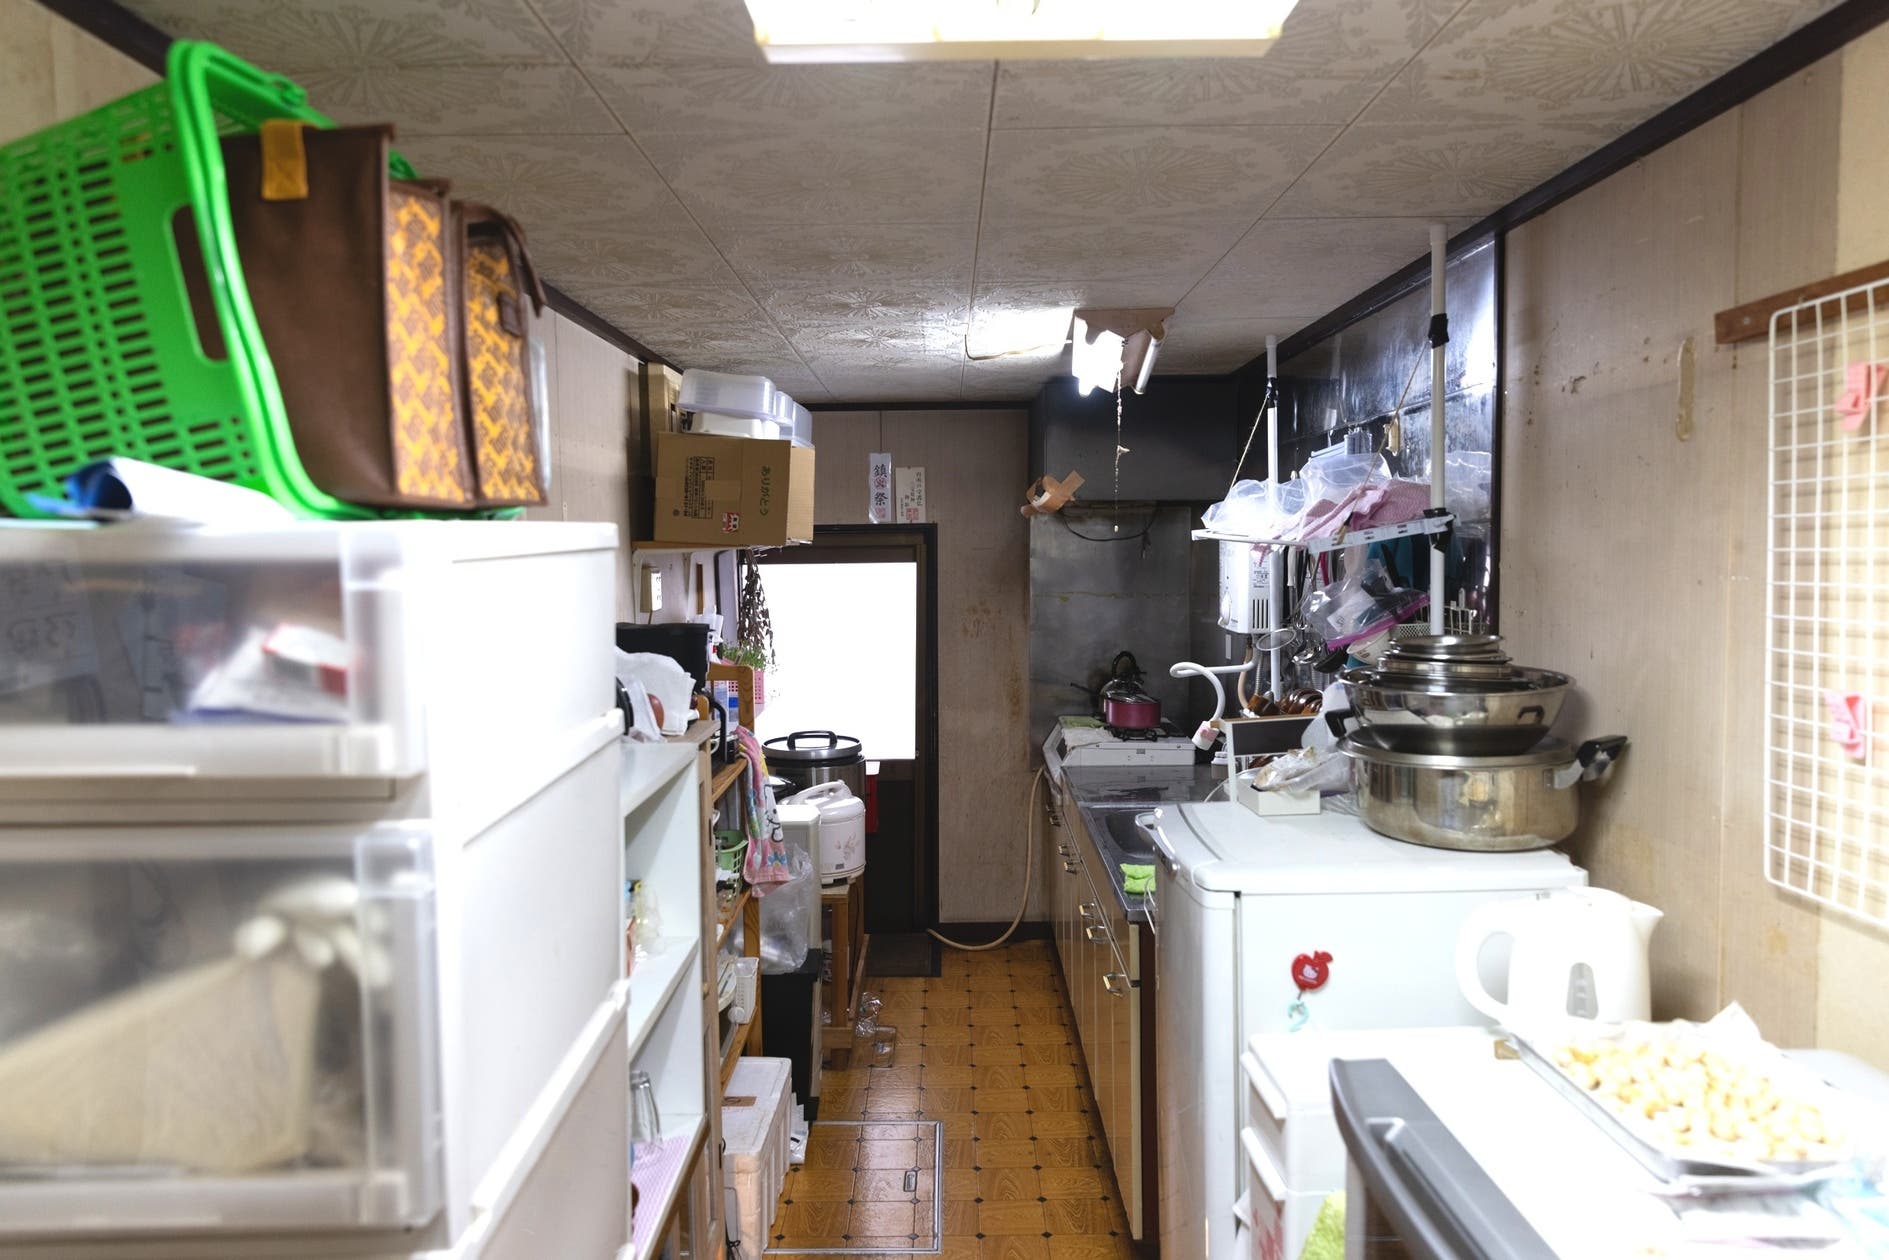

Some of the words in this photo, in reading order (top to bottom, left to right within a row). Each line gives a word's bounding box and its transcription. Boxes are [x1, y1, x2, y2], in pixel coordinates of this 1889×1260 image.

[760, 465, 771, 516] ありがとう
[873, 463, 888, 506] 鎮火祭
